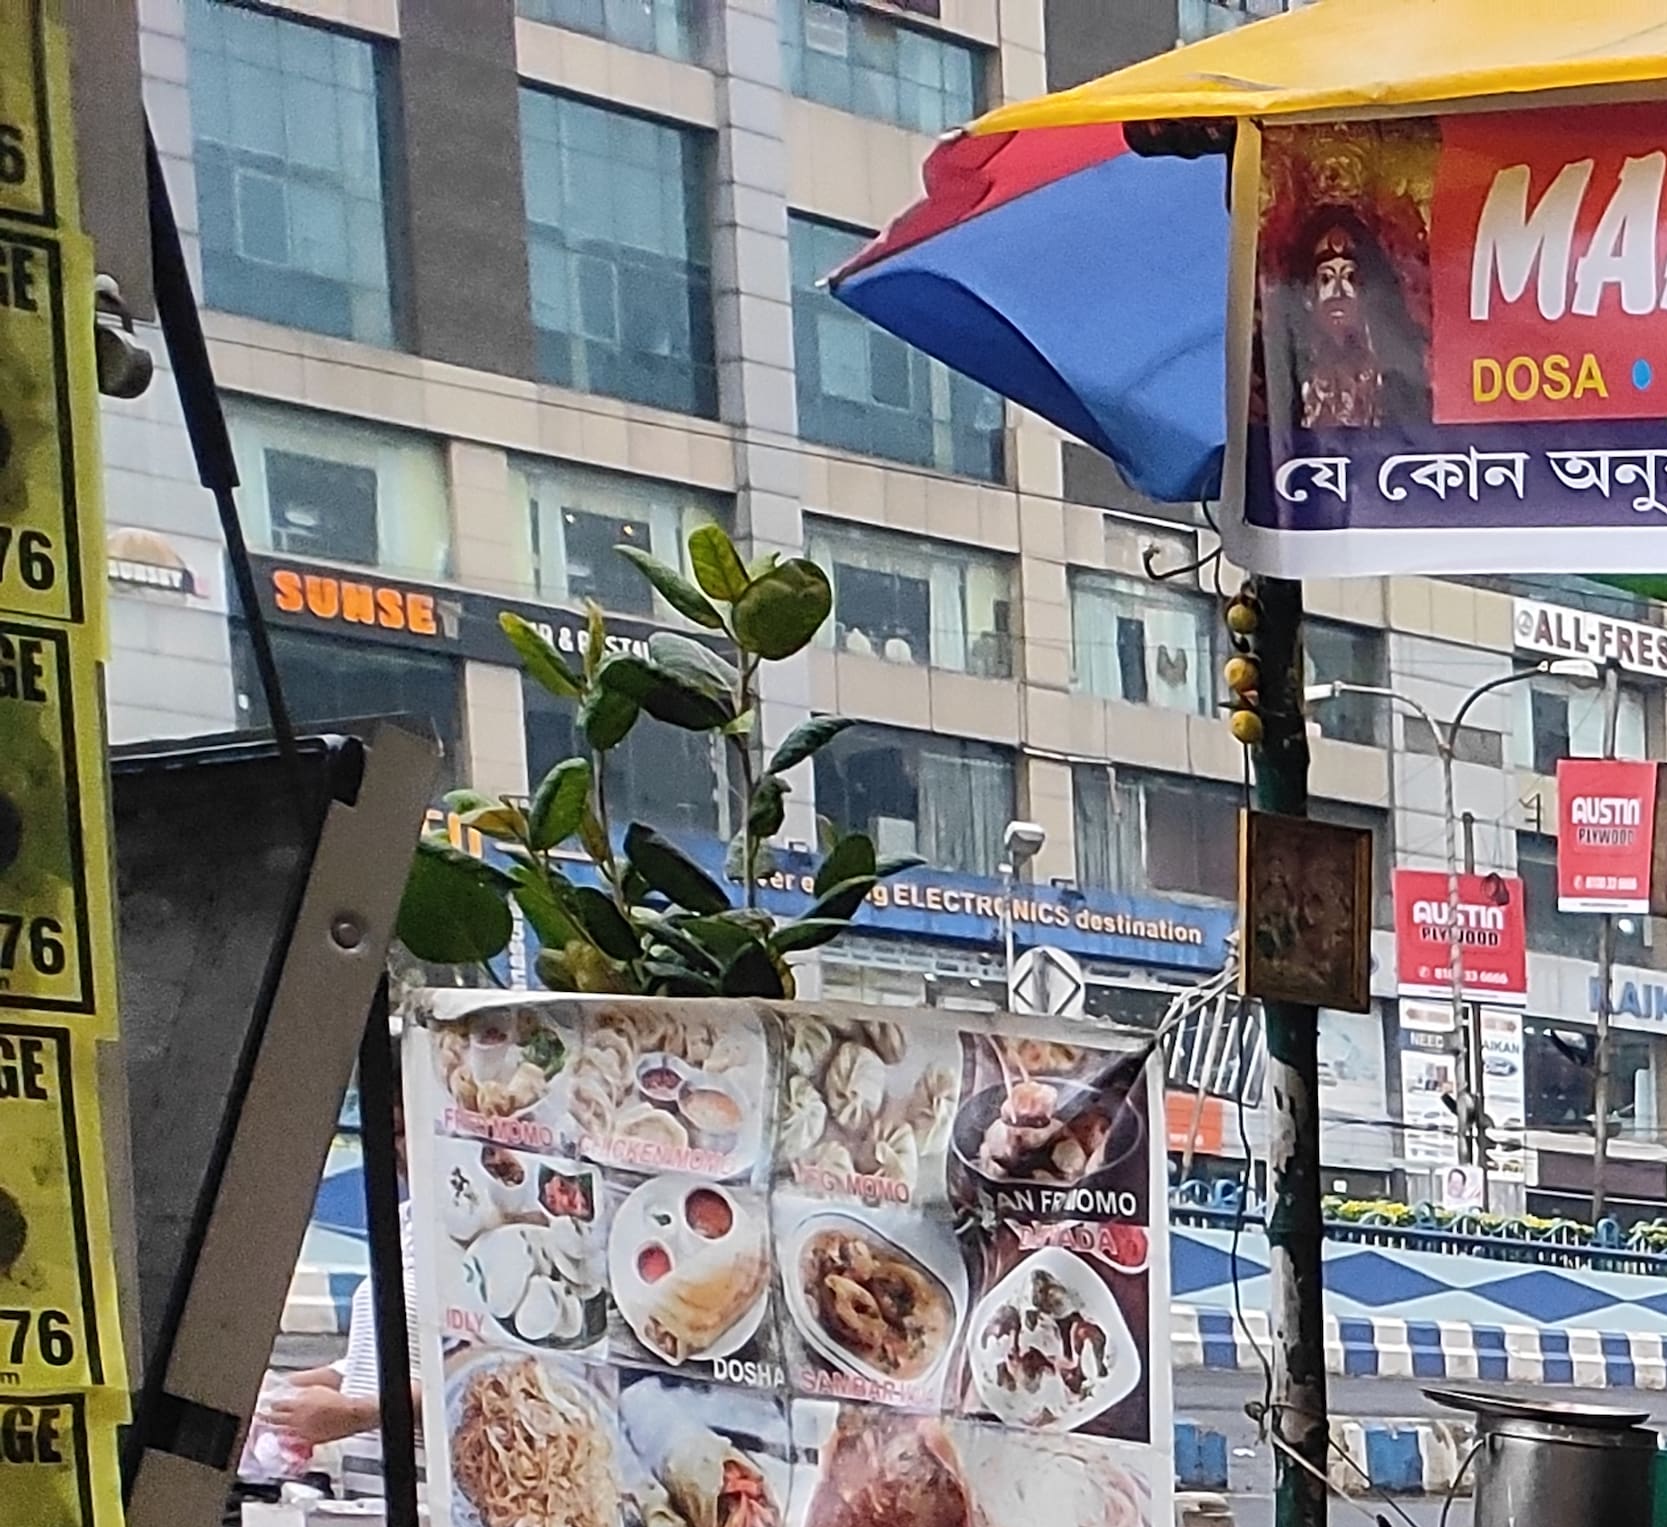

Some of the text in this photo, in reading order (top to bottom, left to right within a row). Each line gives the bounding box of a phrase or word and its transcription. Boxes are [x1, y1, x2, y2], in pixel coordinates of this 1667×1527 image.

[1470, 350, 1608, 401] DOSA
[1276, 452, 1354, 505] যে
[1381, 447, 1527, 503] কোন
[1571, 796, 1641, 825] AUSTIN
[1577, 827, 1636, 846] PLYWOOD
[893, 883, 1070, 928] ELECTRONICS
[1075, 910, 1203, 945] destination
[1412, 900, 1505, 930] AUSTIN
[846, 1176, 909, 1202] MOMO
[444, 1306, 485, 1333] IDLY
[712, 1358, 786, 1387] DOSHA
